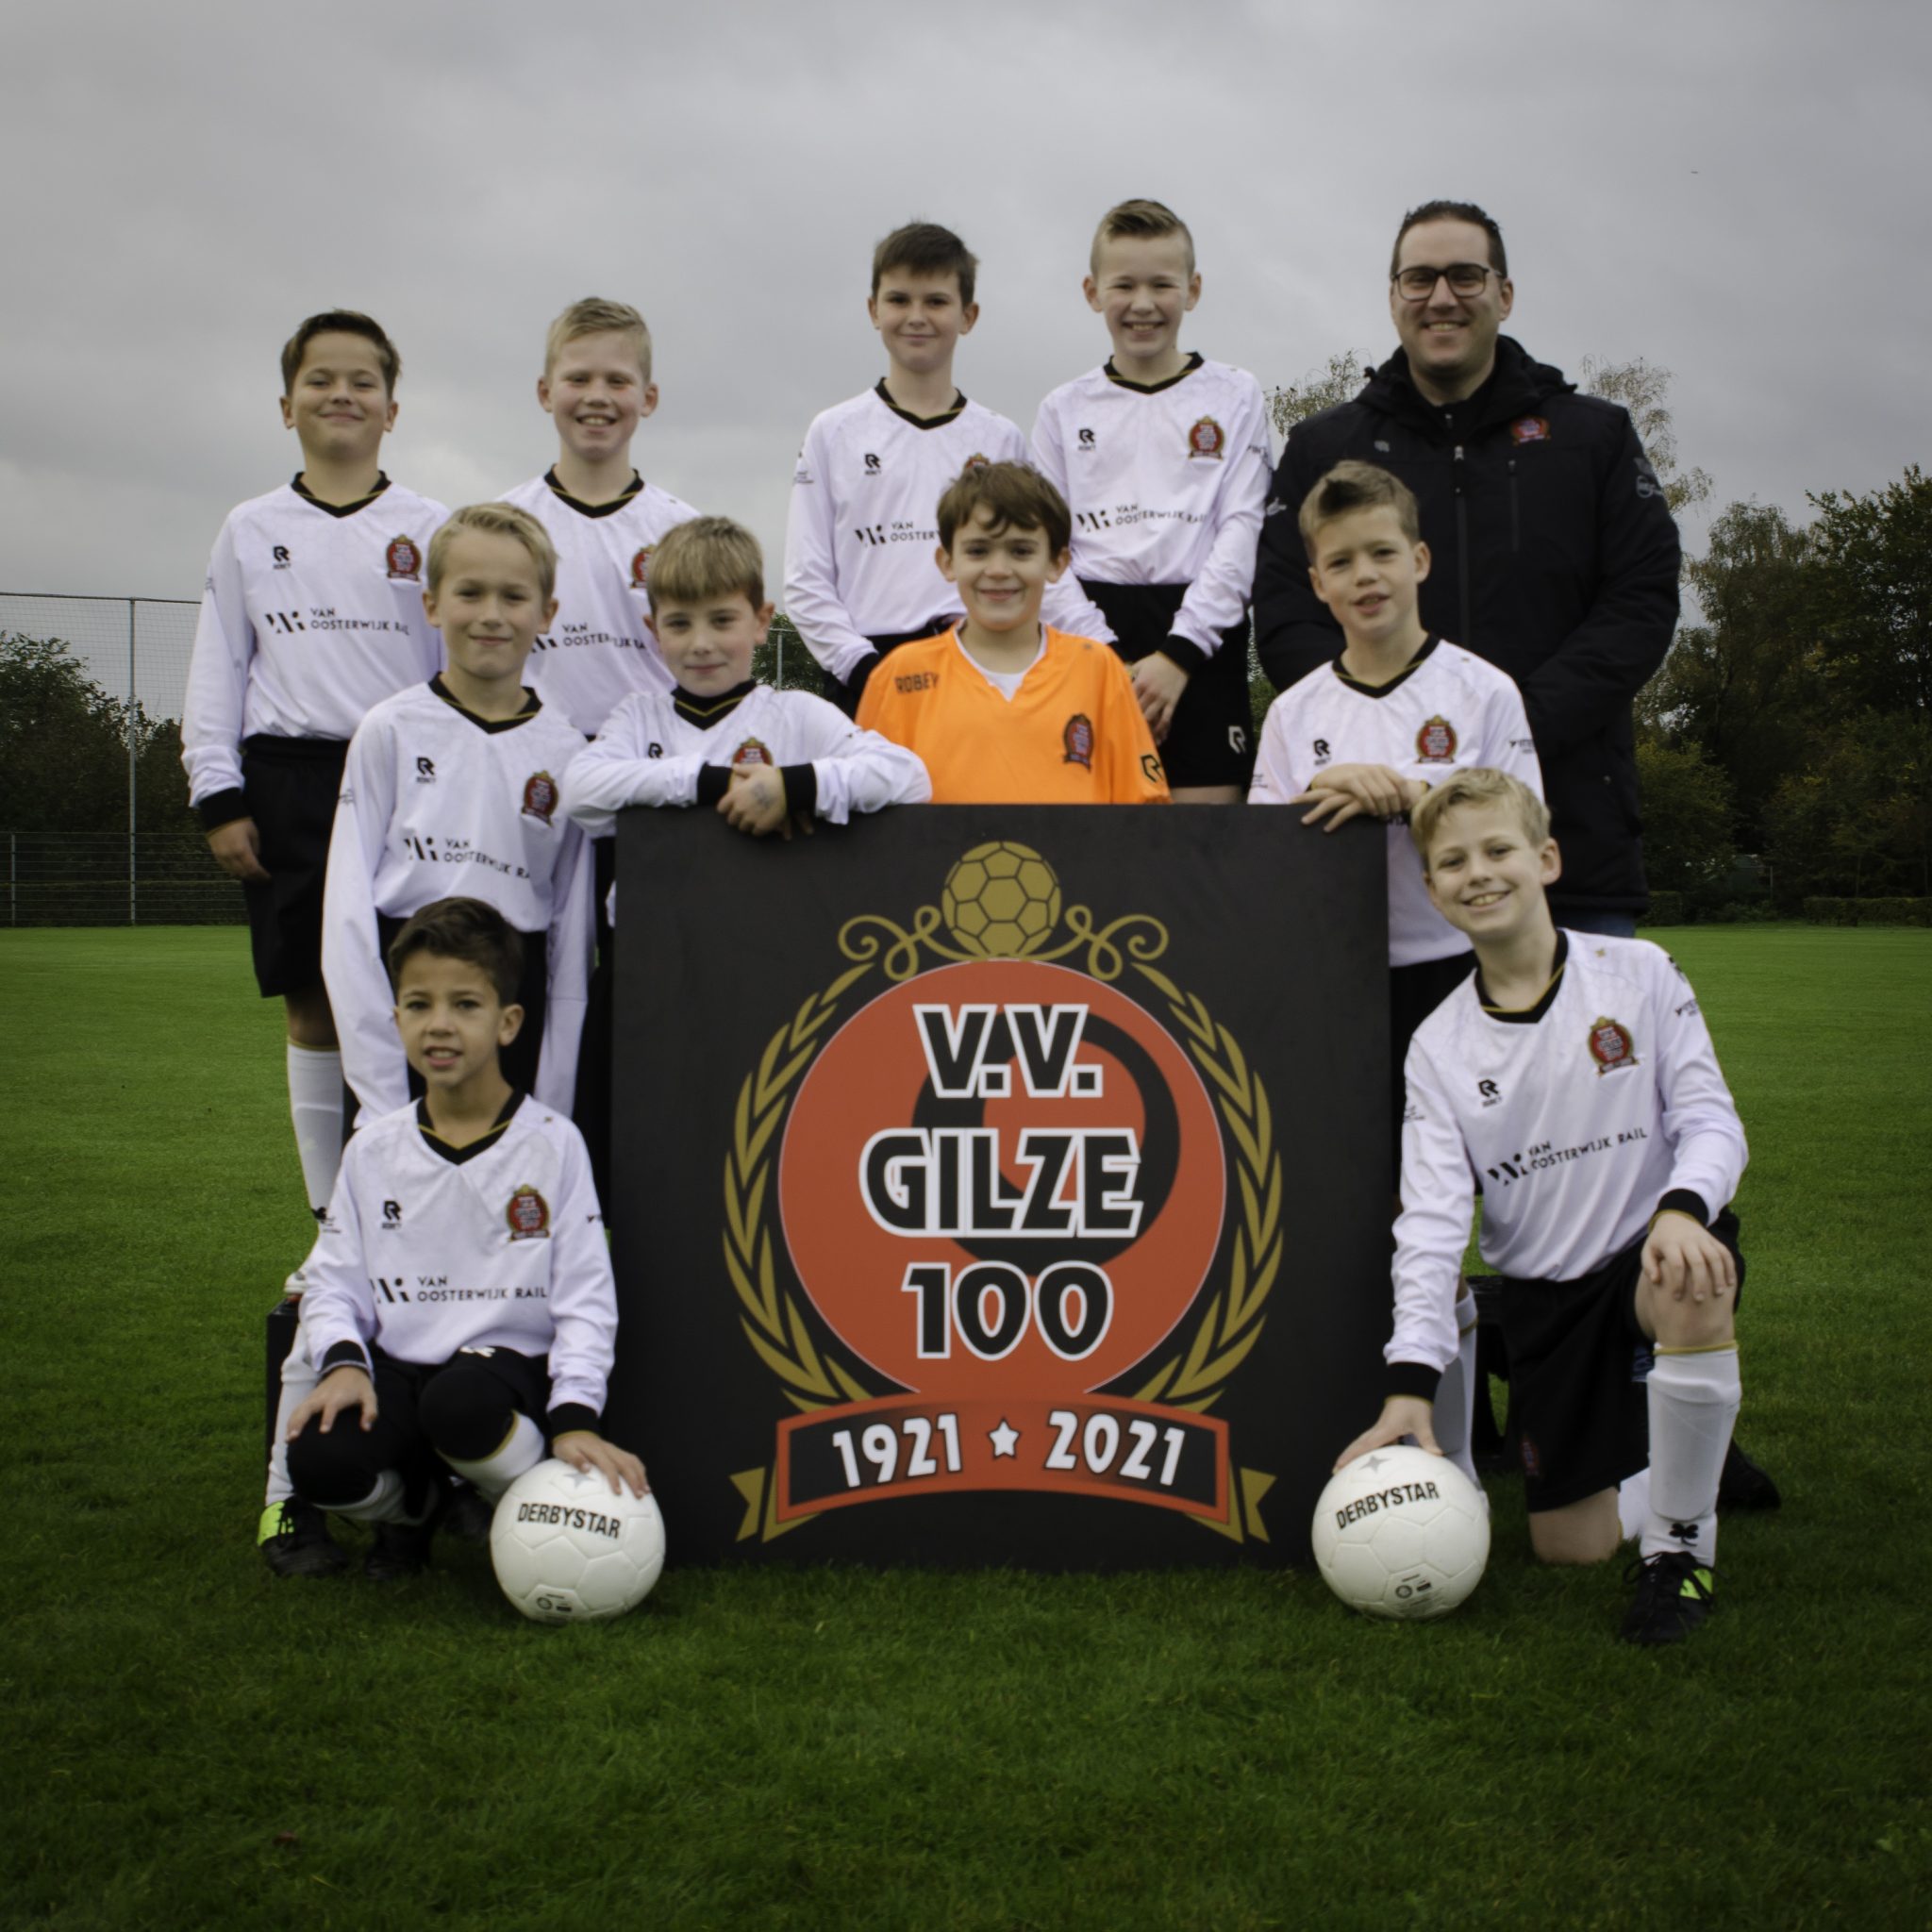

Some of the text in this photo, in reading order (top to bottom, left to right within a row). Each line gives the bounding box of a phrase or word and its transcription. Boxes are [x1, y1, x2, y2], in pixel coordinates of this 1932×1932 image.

[891, 522, 913, 530] VAN
[891, 530, 939, 542] OOSTER
[310, 608, 336, 618] VAN
[310, 619, 390, 632] OOSTERWIJK
[562, 622, 588, 634] VAN
[563, 633, 631, 648] OOSTERIJK
[894, 672, 940, 695] ROBEY
[445, 838, 471, 849] VAN
[912, 1003, 1105, 1098] V.V.
[1617, 1127, 1648, 1145] RAIL
[1528, 1140, 1552, 1157] VAN
[858, 1127, 1143, 1238] GILZE
[418, 1275, 448, 1287] VAN
[417, 1287, 548, 1303] OOSTERWIJK RAIL
[902, 1260, 1114, 1361] 100
[832, 1411, 1186, 1488] 1921 2021
[1336, 1481, 1440, 1530] DERBYSTAR
[517, 1503, 622, 1540] DERBYSTAR
